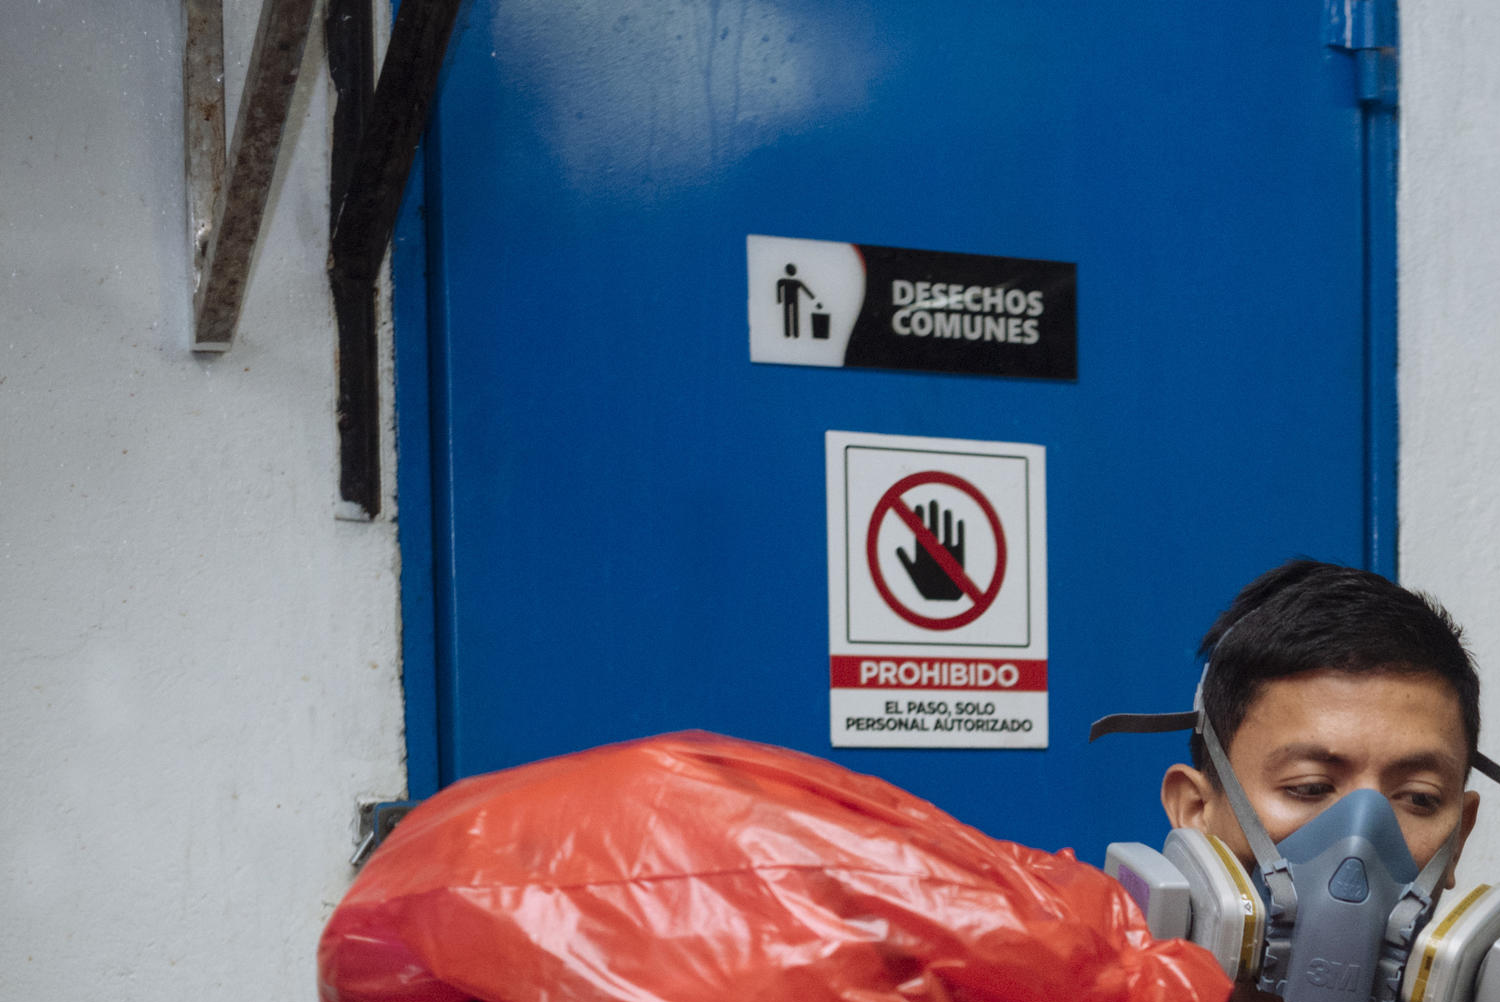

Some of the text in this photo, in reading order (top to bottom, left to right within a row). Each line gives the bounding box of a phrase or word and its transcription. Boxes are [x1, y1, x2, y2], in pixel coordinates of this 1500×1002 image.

[892, 279, 1044, 316] DESECHOS
[892, 310, 1040, 345] COMUNES
[860, 660, 1020, 687] PROHIBIDO
[846, 717, 1033, 732] PERSONAL AUTORIZADO
[885, 701, 996, 717] EL PASO, SOLO
[1305, 957, 1360, 993] 3M
